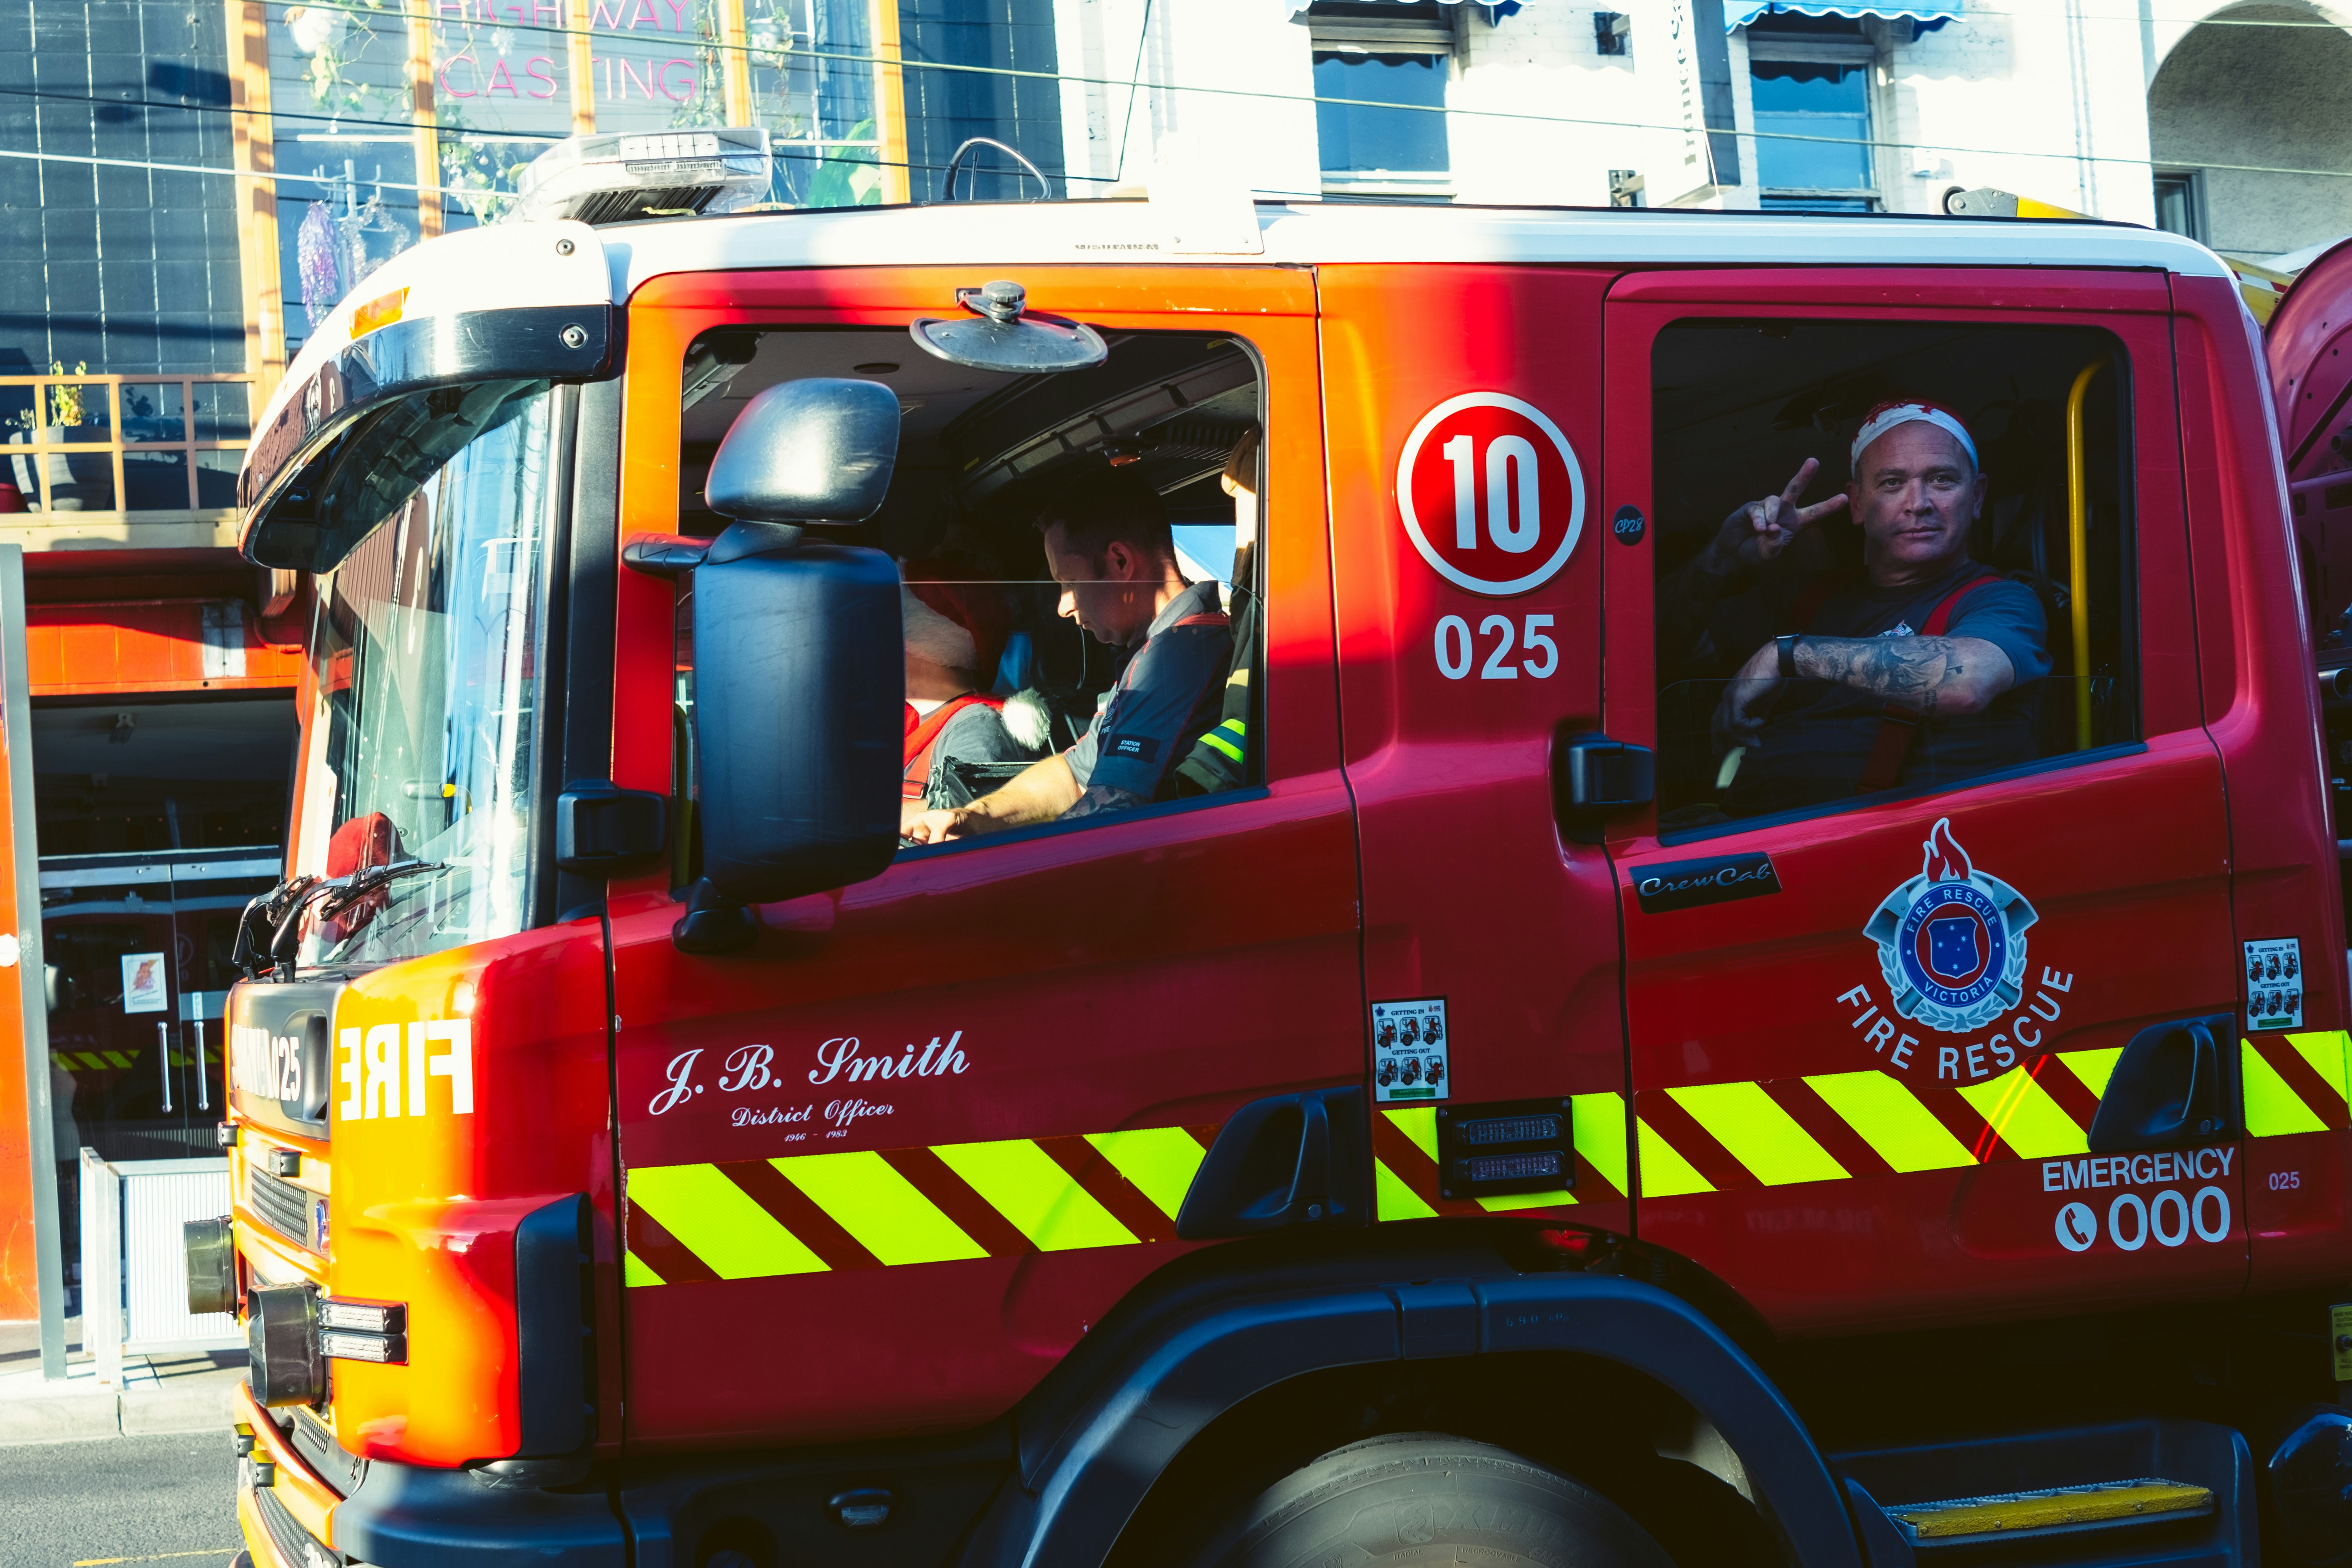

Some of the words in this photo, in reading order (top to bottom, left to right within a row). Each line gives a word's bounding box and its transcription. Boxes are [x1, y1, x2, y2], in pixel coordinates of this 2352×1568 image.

[439, 55, 695, 101] CASING
[1443, 434, 1540, 554] 10
[1434, 614, 1558, 680] 025
[1120, 739, 1141, 748] STATION
[1907, 897, 1934, 932] FIRE
[1943, 889, 1997, 927] RESCUE
[1924, 976, 1993, 1003] VICTORIA
[1836, 984, 1919, 1069] FIRE
[1938, 966, 2073, 1079] RESCUE
[271, 1036, 301, 1102] 025
[648, 1048, 704, 1116] J.
[718, 1044, 782, 1092] B.
[809, 1030, 970, 1085] Smith
[732, 1104, 814, 1127] District
[824, 1098, 895, 1127] Officer
[784, 1133, 807, 1142] 1946
[825, 1129, 848, 1139] 1983
[2042, 1147, 2235, 1192] EMERGENCY
[2268, 1171, 2300, 1191] 025
[2108, 1186, 2231, 1251] 000
[1393, 1549, 1423, 1561] RADIAL
[1462, 1547, 1520, 1563] REGROOVABLE
